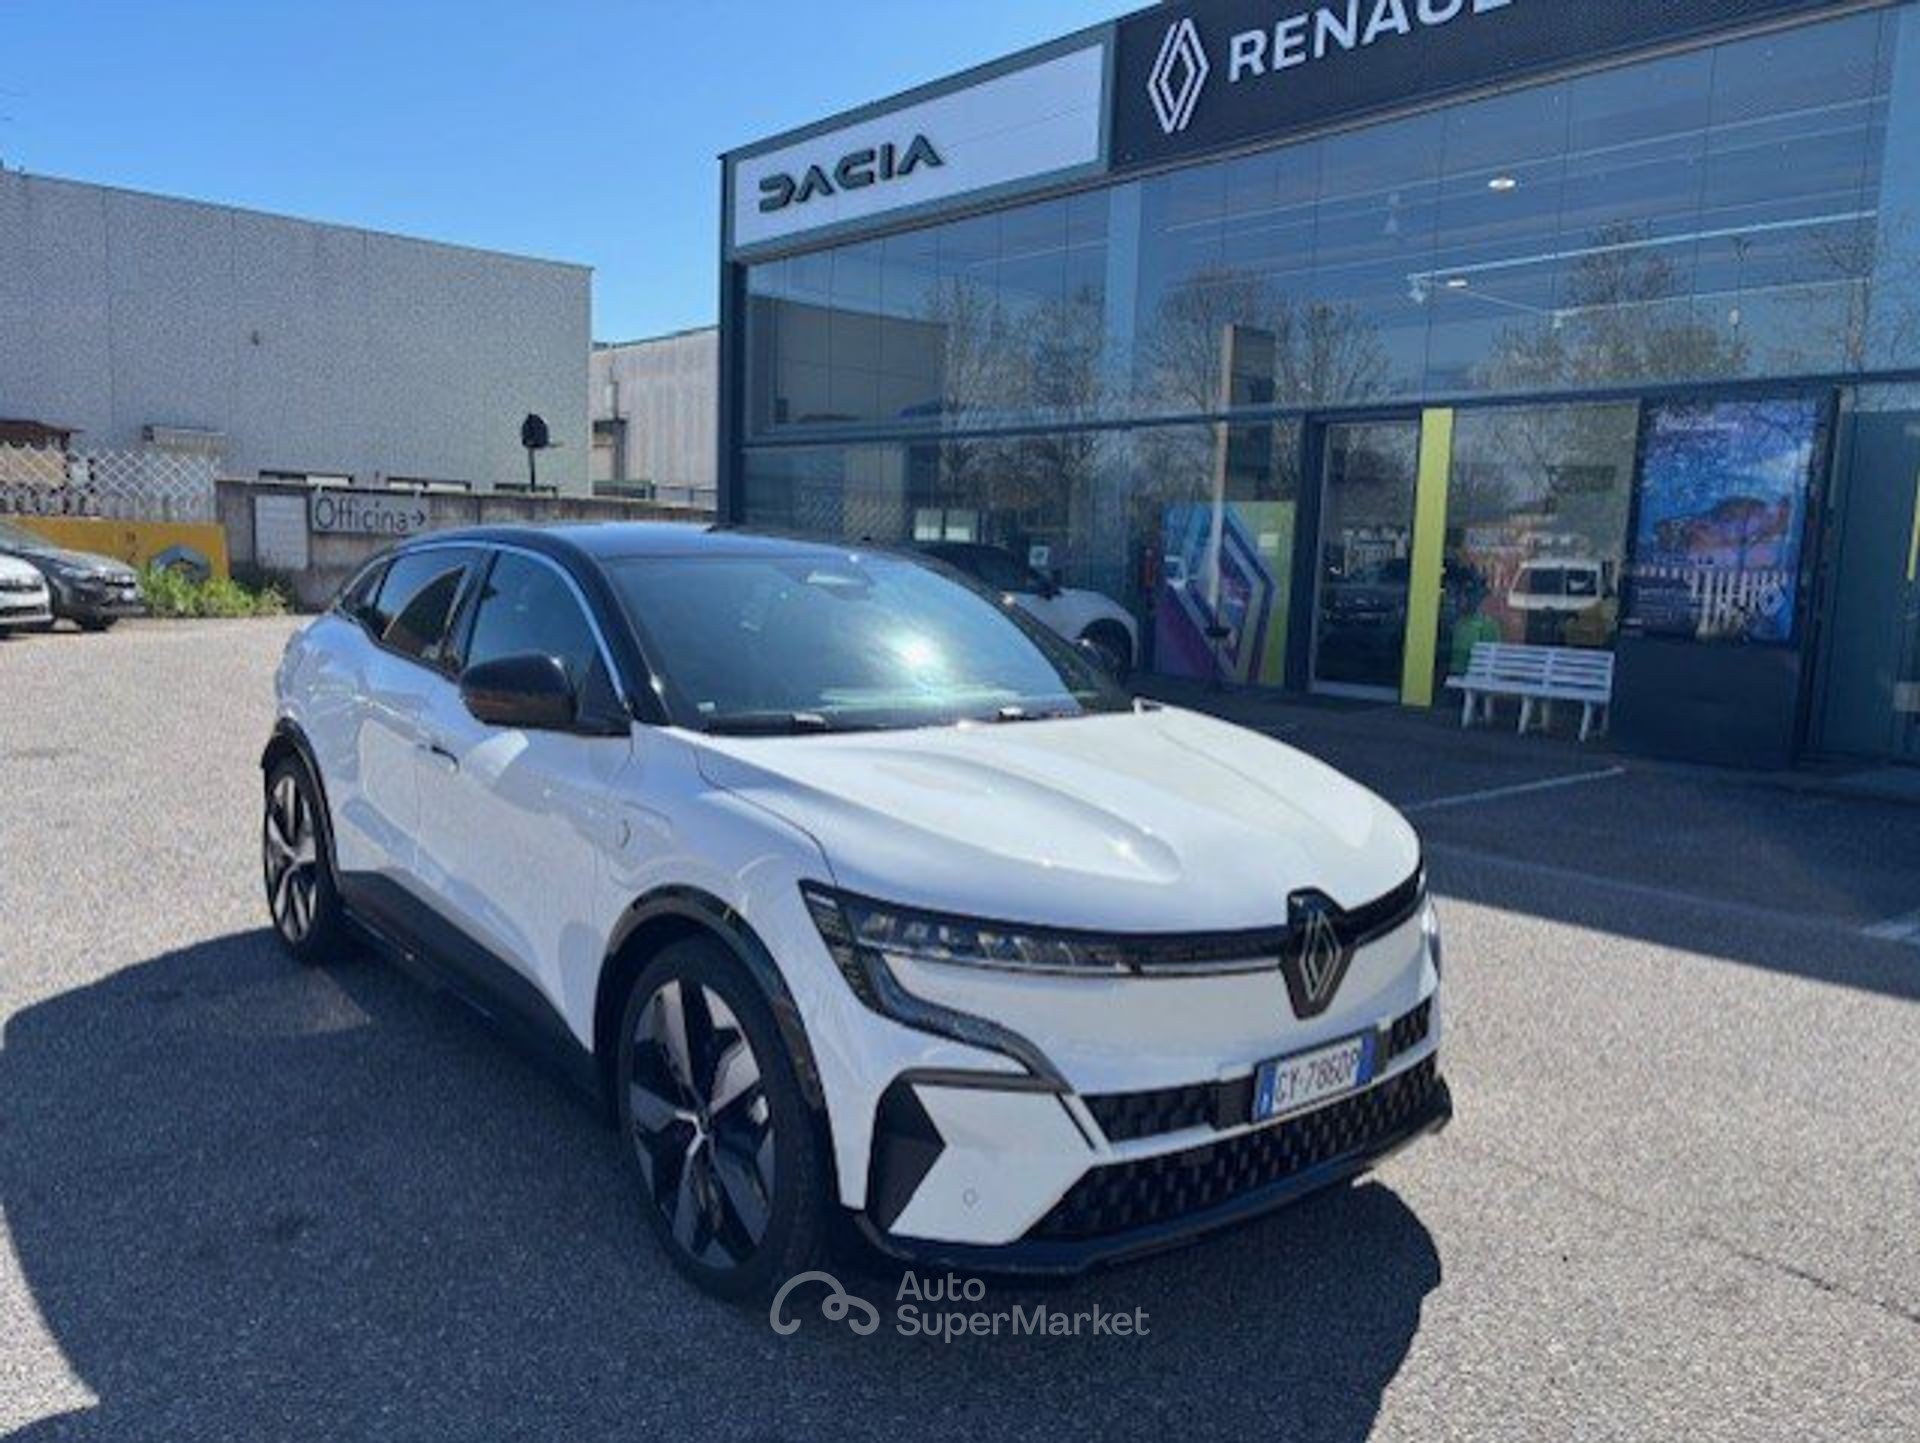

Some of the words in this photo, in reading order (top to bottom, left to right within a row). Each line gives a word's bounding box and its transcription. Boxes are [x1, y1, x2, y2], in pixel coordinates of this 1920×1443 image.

[1229, 0, 1512, 82] RENAU
[759, 134, 944, 213] DACIA
[314, 497, 409, 531] Officina
